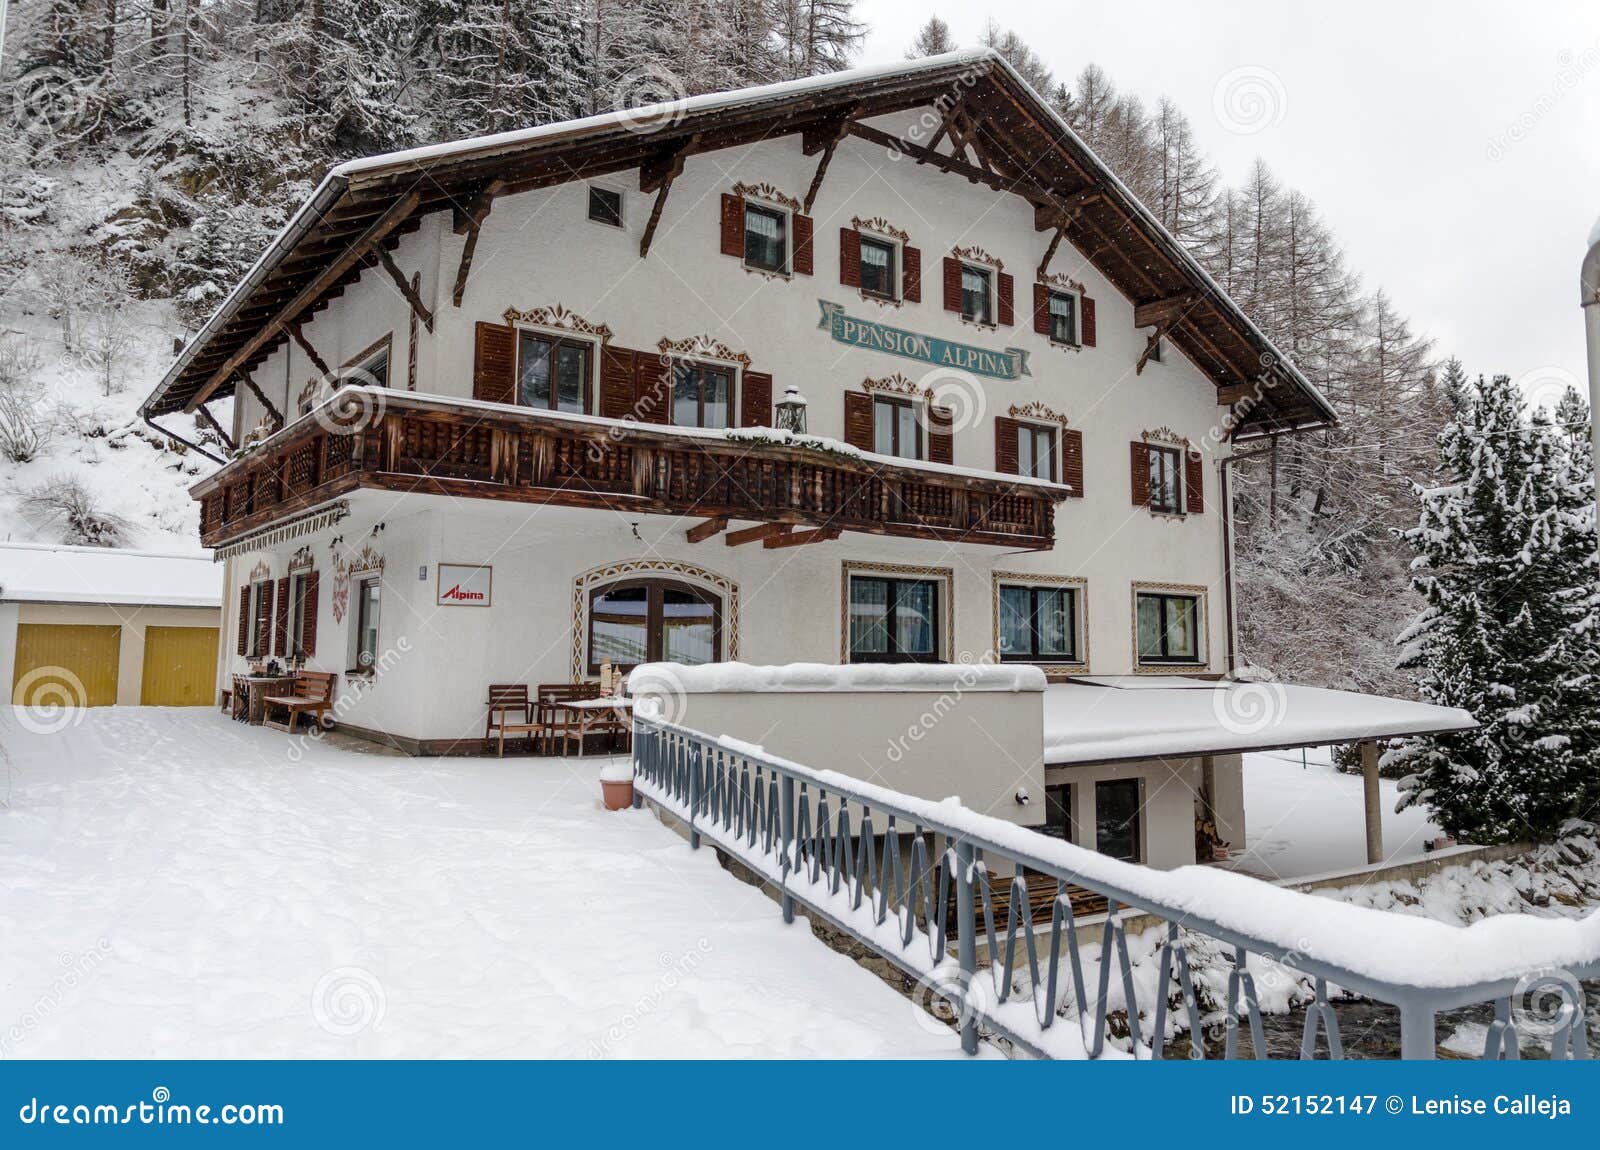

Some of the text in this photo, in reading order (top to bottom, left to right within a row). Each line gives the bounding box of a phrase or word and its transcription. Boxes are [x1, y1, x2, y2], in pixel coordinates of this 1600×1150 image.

[842, 320, 1008, 376] PENSION ALPINA
[441, 584, 484, 600] Alpina
